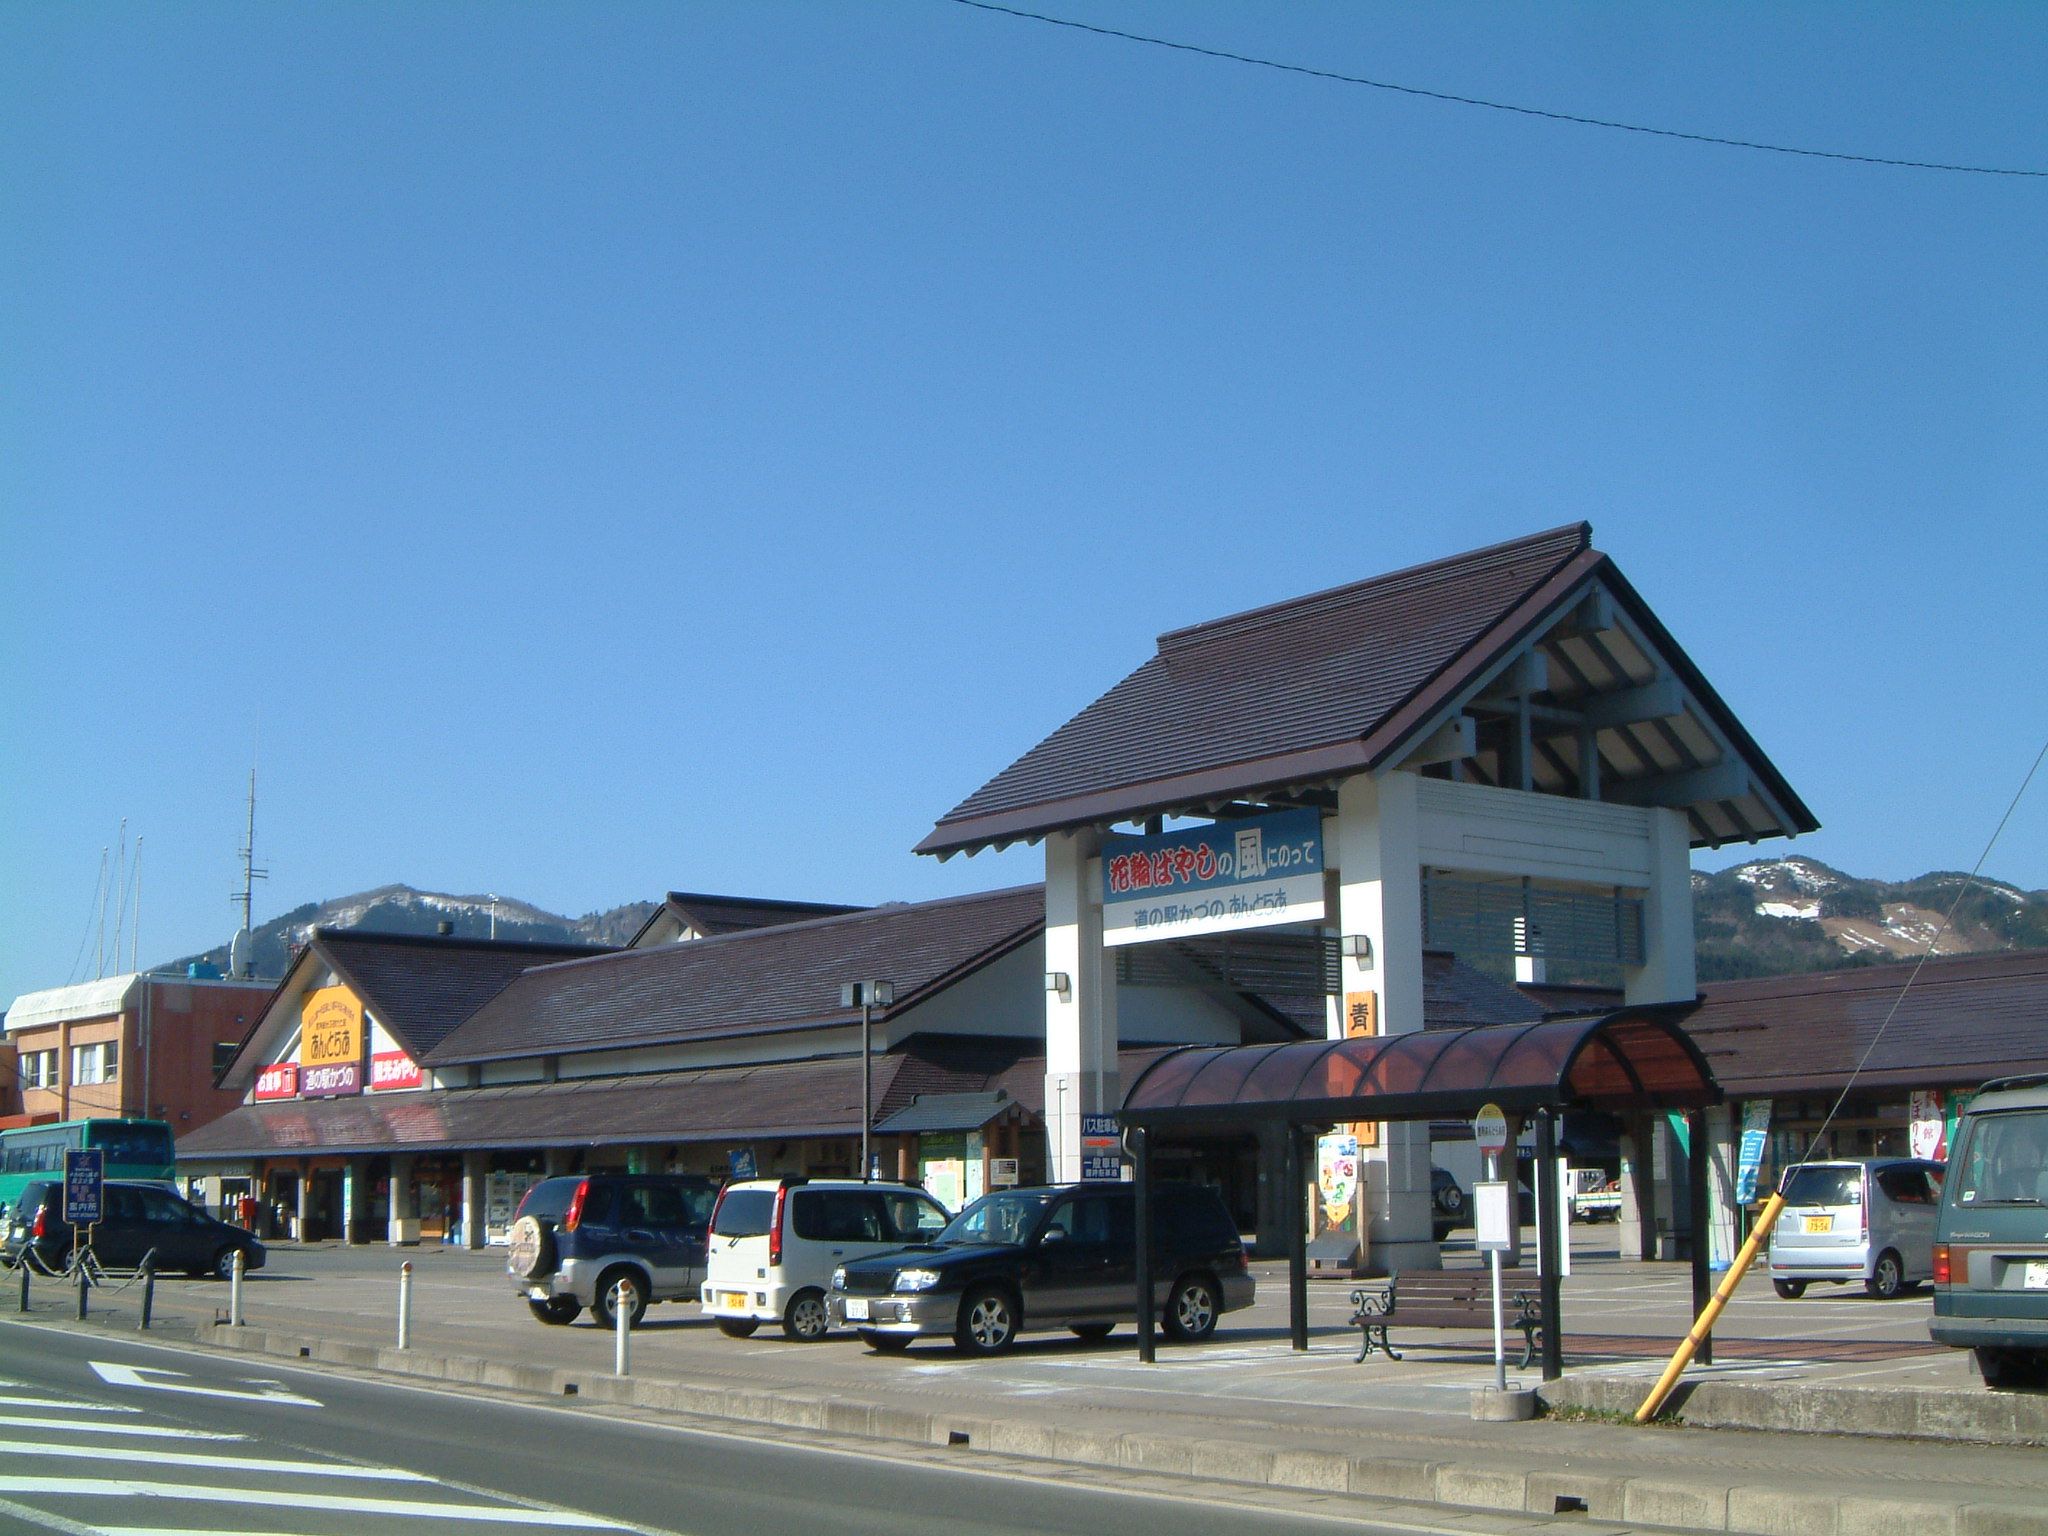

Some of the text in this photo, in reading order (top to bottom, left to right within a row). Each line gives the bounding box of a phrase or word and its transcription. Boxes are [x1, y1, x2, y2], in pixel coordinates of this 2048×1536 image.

[1110, 828, 1315, 893] 花輪ばやしの風にのって
[1134, 887, 1287, 930] 道の駅かづの あんとらあ
[311, 1030, 351, 1060] あんとらあ
[305, 1066, 355, 1091] 道の駅かづの
